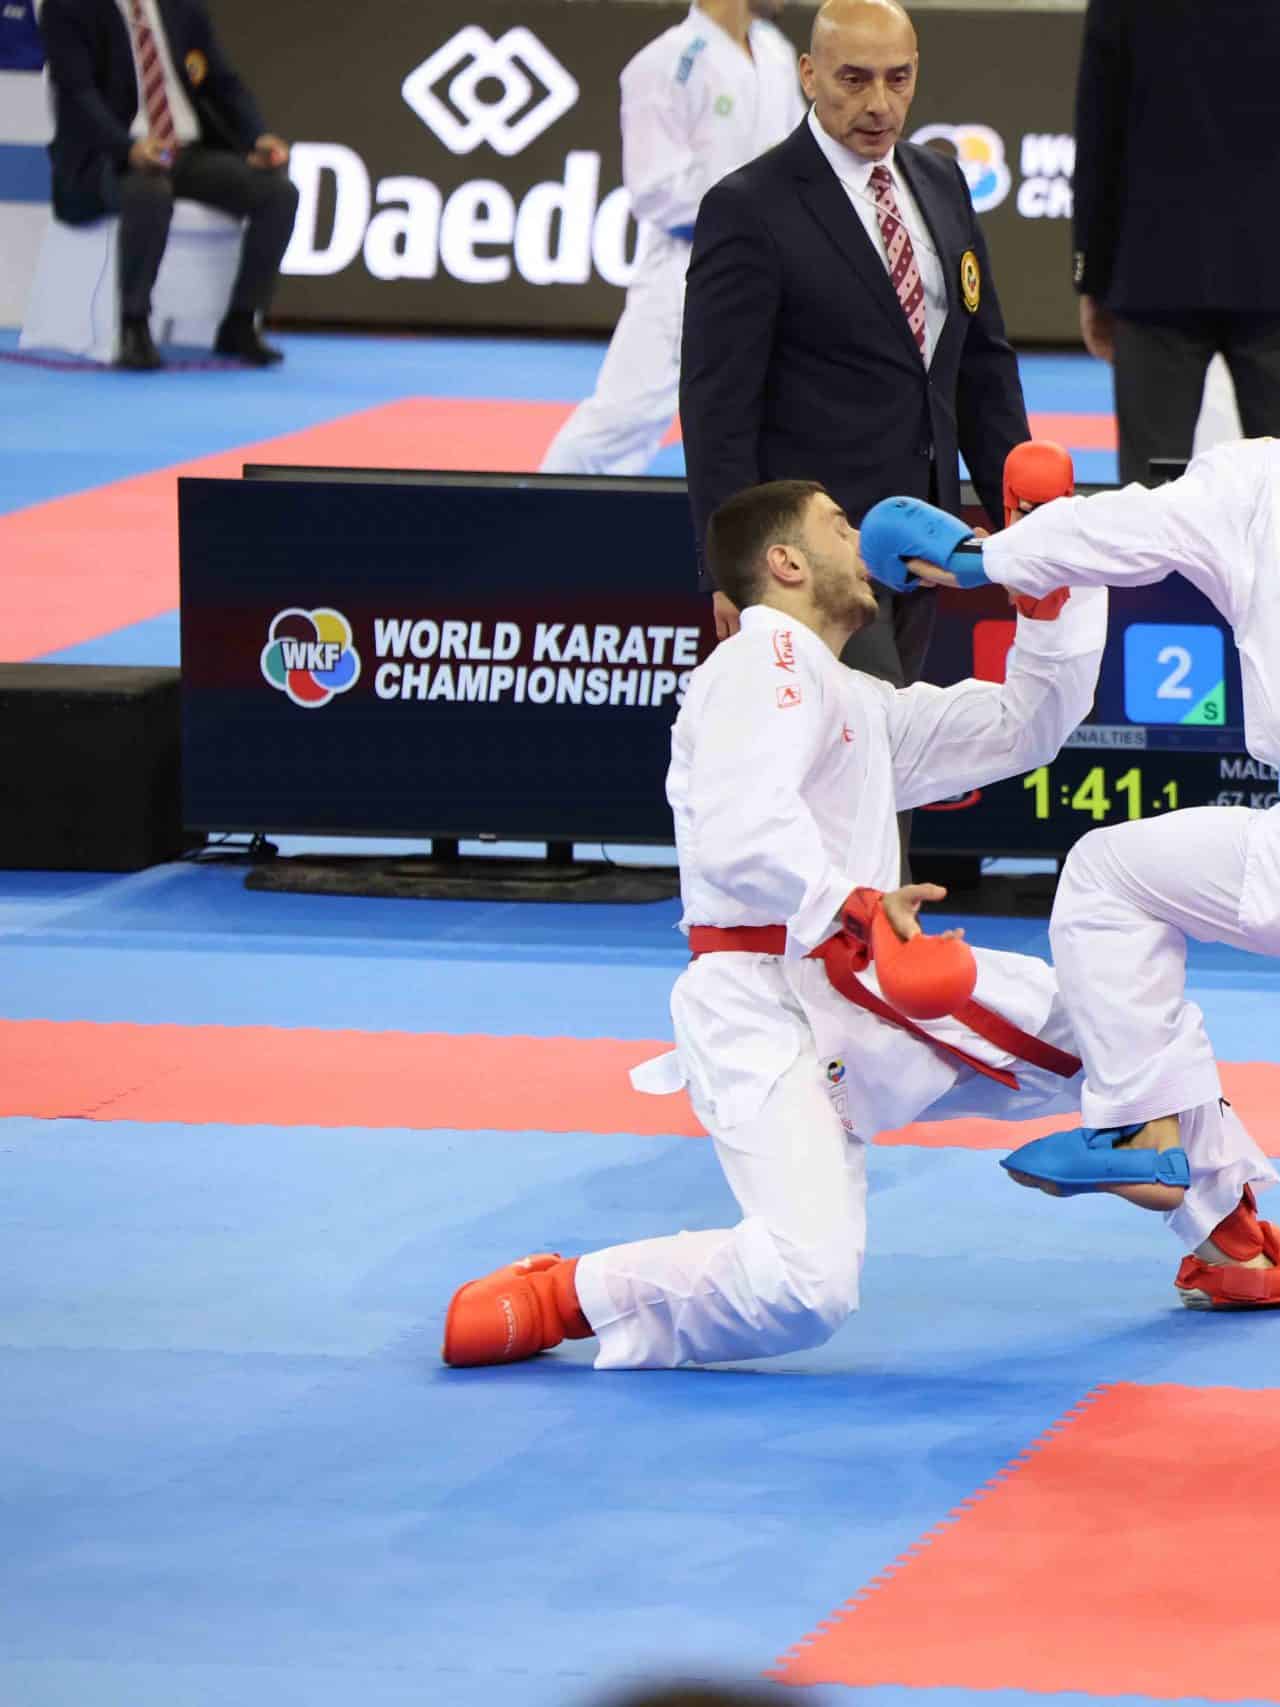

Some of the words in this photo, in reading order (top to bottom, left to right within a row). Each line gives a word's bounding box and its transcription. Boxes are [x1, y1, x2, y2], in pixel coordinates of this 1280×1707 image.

[281, 641, 343, 672] WKF
[373, 618, 521, 661] WORLD
[532, 623, 700, 667] KARATE
[1156, 646, 1194, 701] 2
[1204, 702, 1219, 722] S
[1023, 766, 1179, 821] 1:41.1
